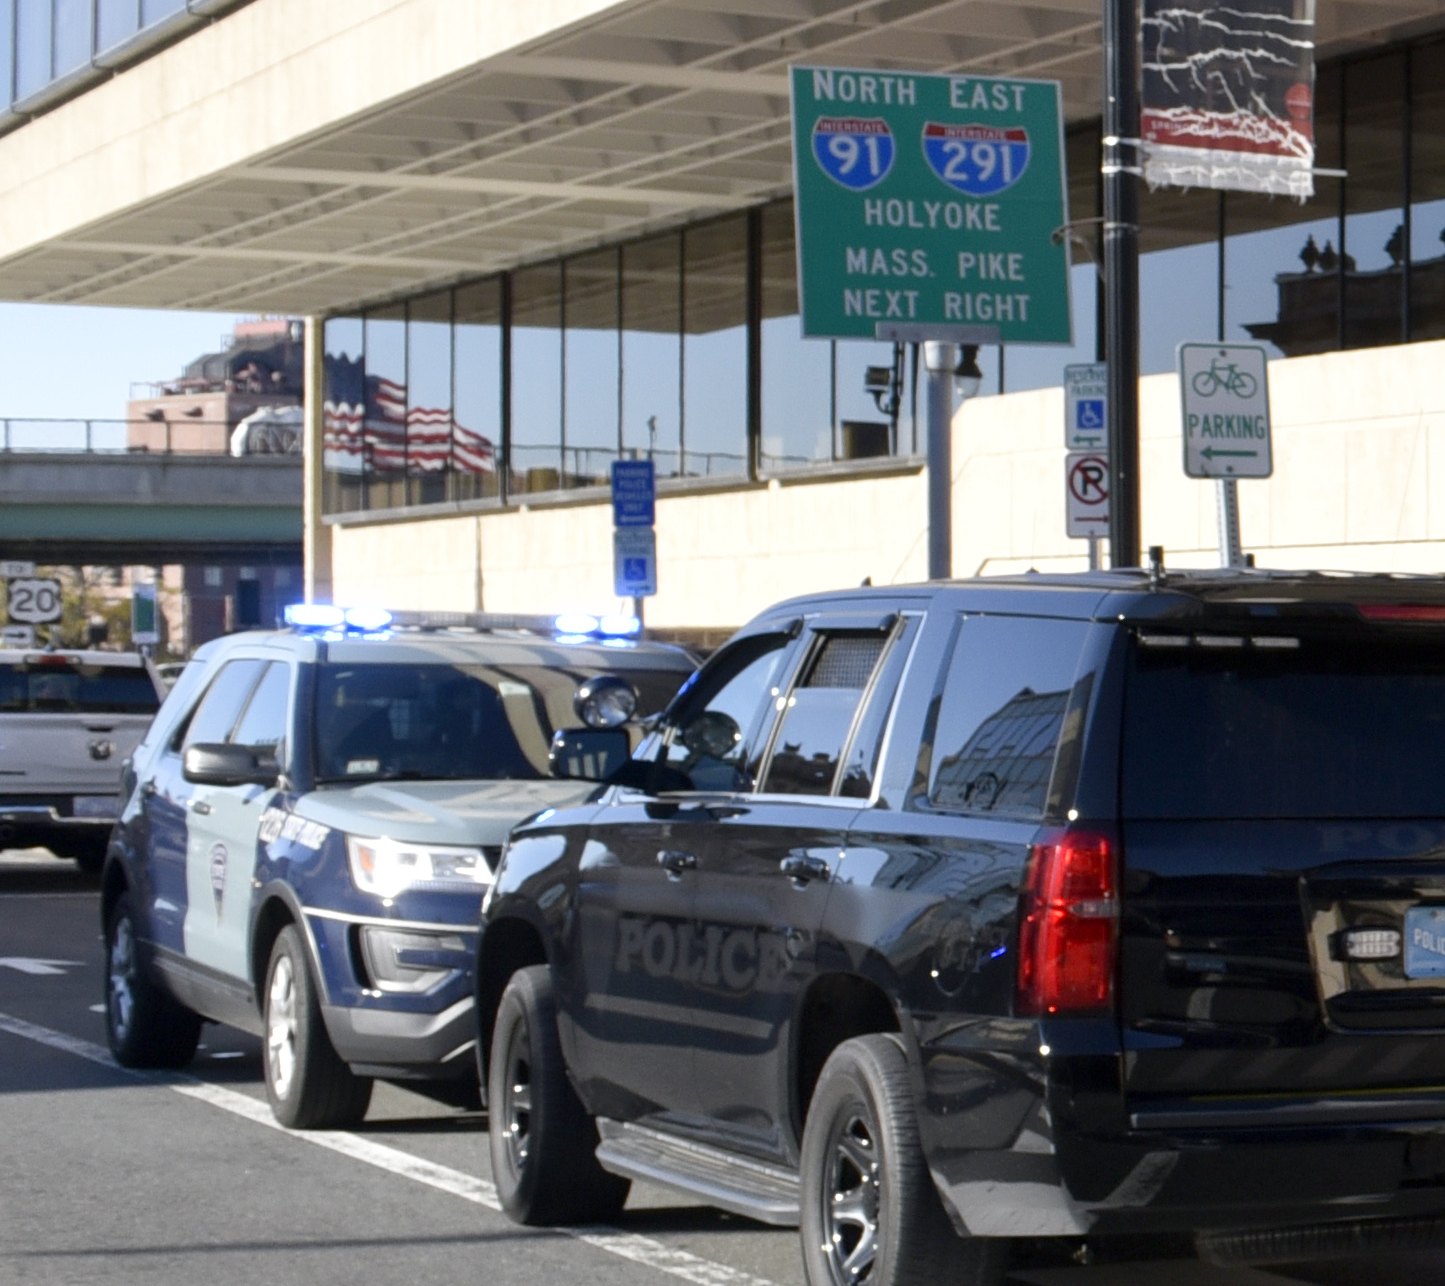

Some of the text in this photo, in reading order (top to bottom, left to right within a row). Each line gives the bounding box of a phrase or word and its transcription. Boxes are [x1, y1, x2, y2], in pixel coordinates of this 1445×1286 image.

[813, 71, 1026, 111] NORTH EAST
[820, 122, 884, 134] INTERSTATE
[944, 127, 1008, 140] INTERSTATE
[828, 136, 880, 176] 91
[942, 142, 1012, 183] 291
[864, 199, 1001, 230] HOLYOKE
[846, 247, 1024, 281] MASS. PIKE
[844, 289, 1030, 321] NEXT RIGHT
[1188, 413, 1267, 439] PARKING
[15, 589, 55, 612] 20
[615, 918, 790, 994] POLICE
